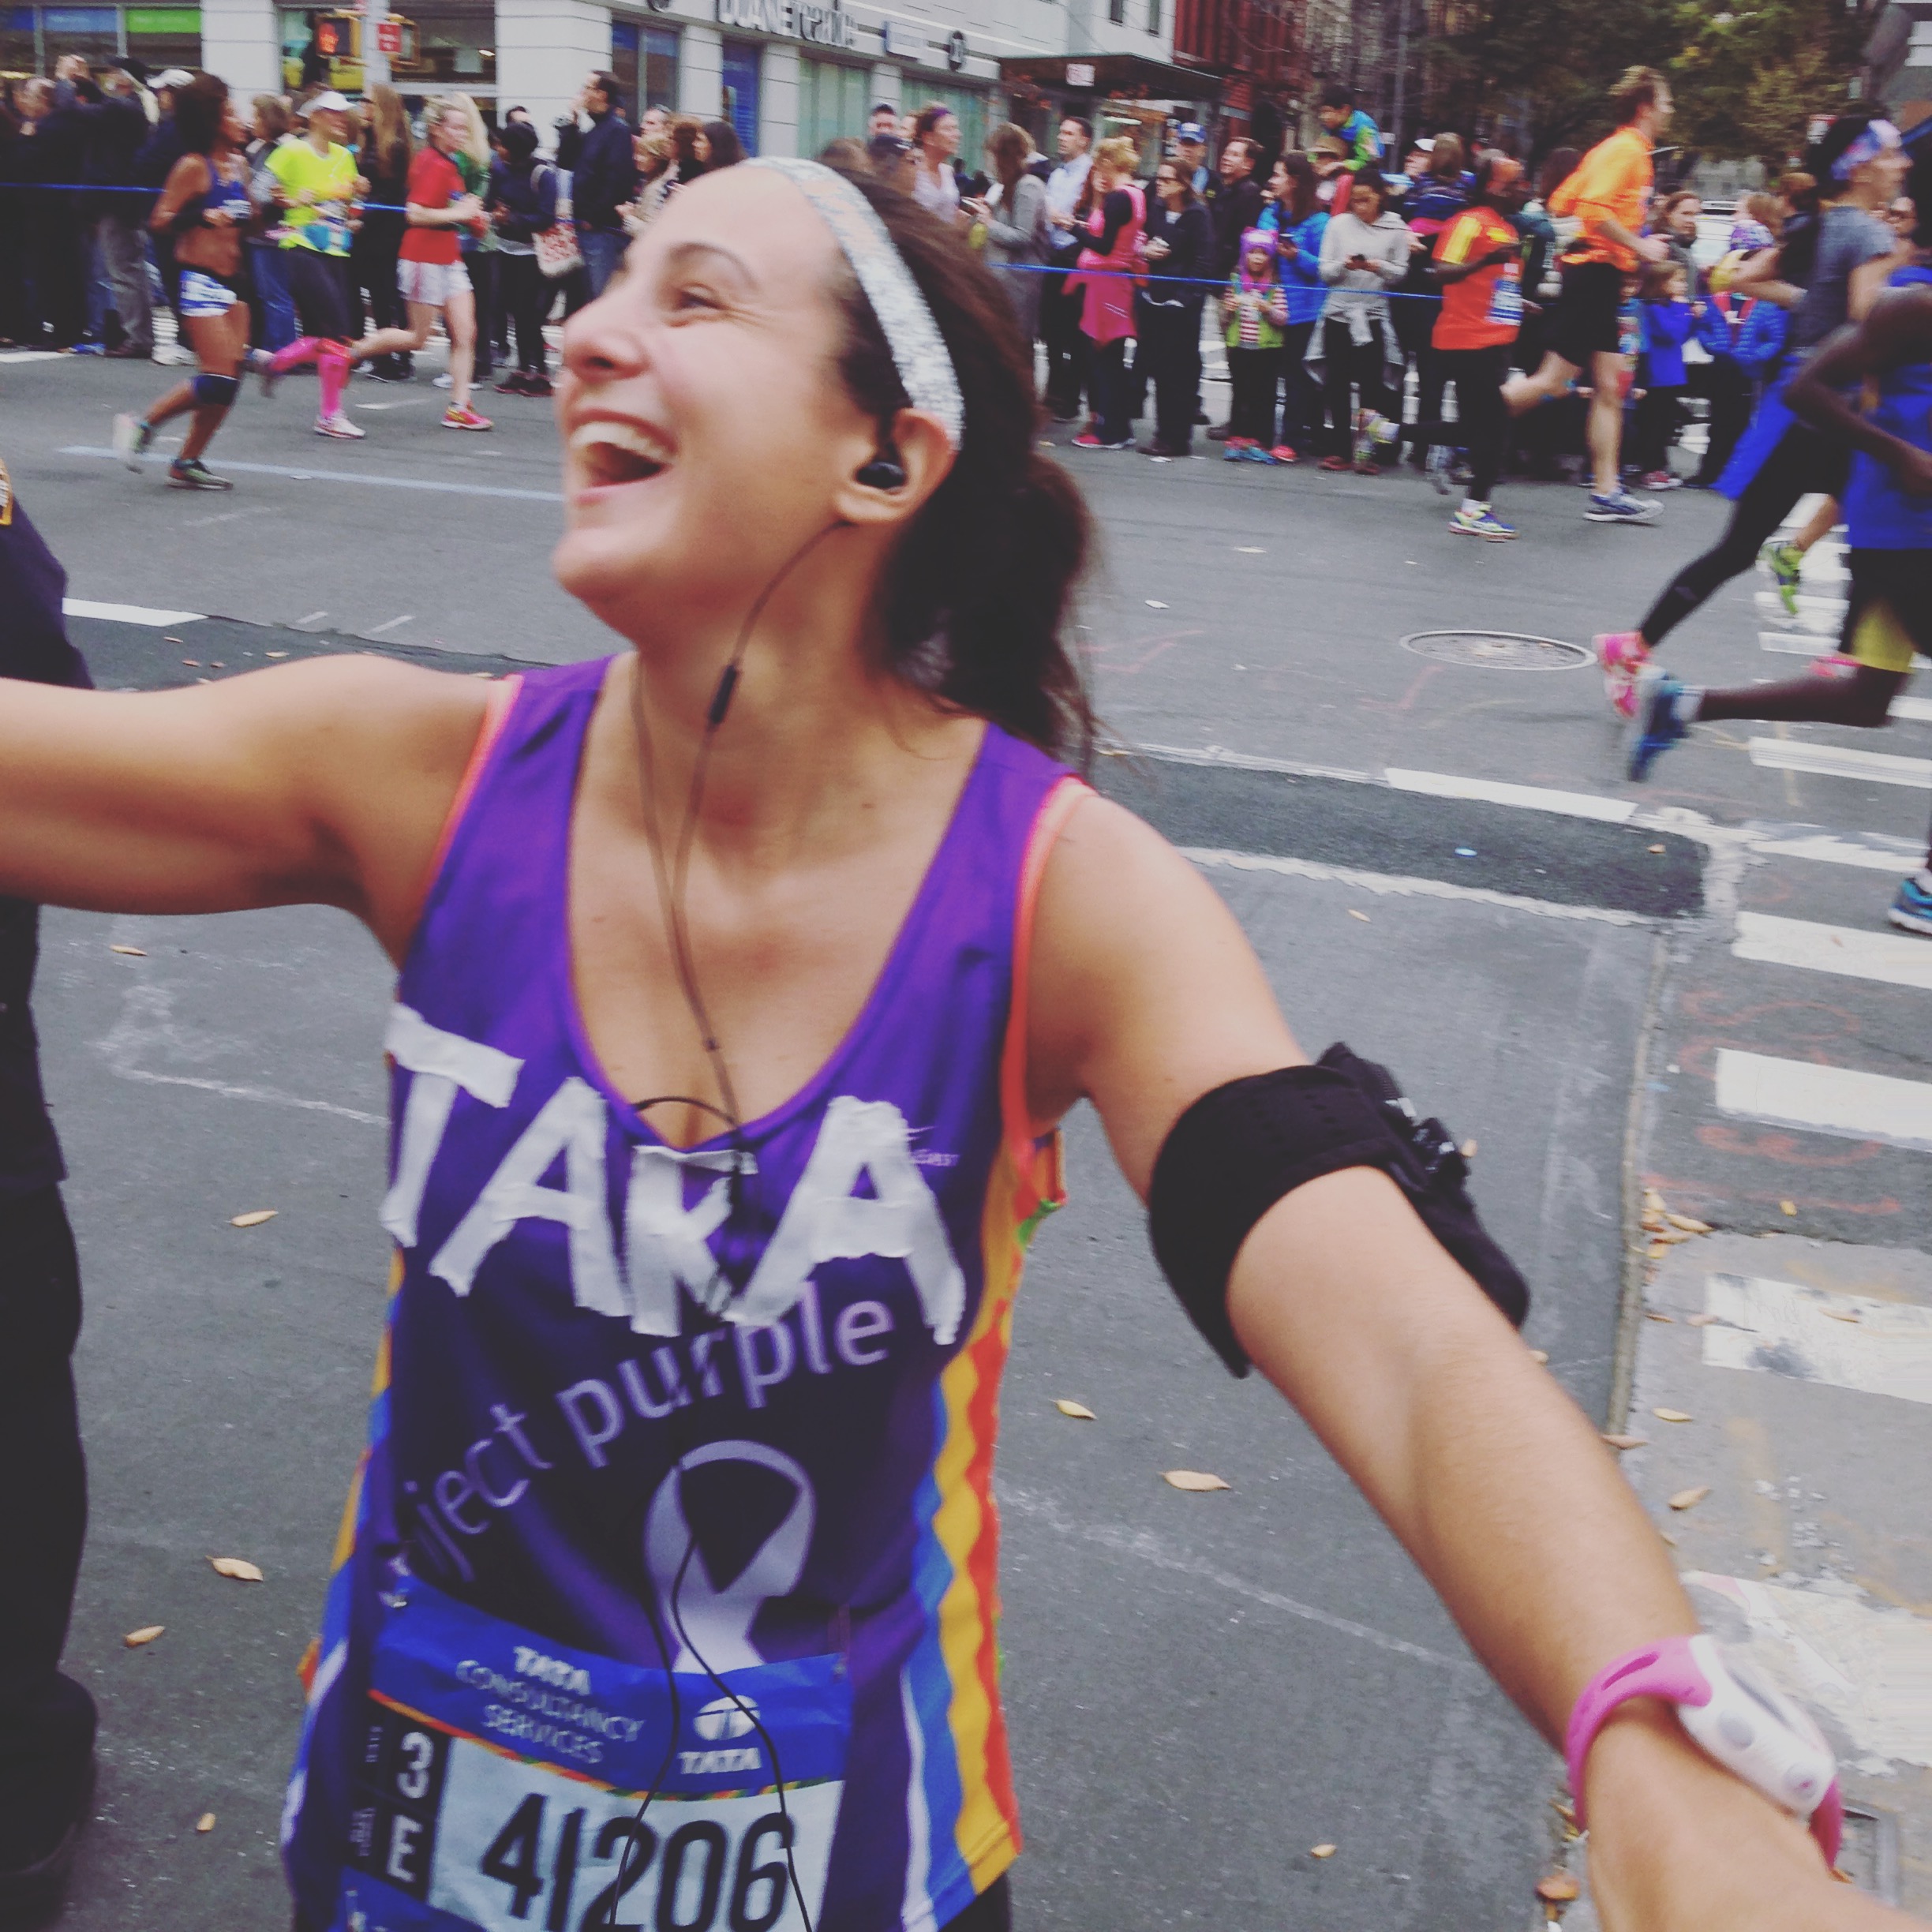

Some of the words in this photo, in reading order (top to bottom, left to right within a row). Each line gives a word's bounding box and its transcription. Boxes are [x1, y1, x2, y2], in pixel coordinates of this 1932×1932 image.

[554, 1279, 896, 1469] purple
[455, 1660, 645, 1743] CONSULTANCY
[513, 1646, 591, 1696] TATA
[481, 1704, 604, 1765] SERVICES
[679, 1747, 762, 1775] TATA
[477, 1792, 796, 1932] 41206
